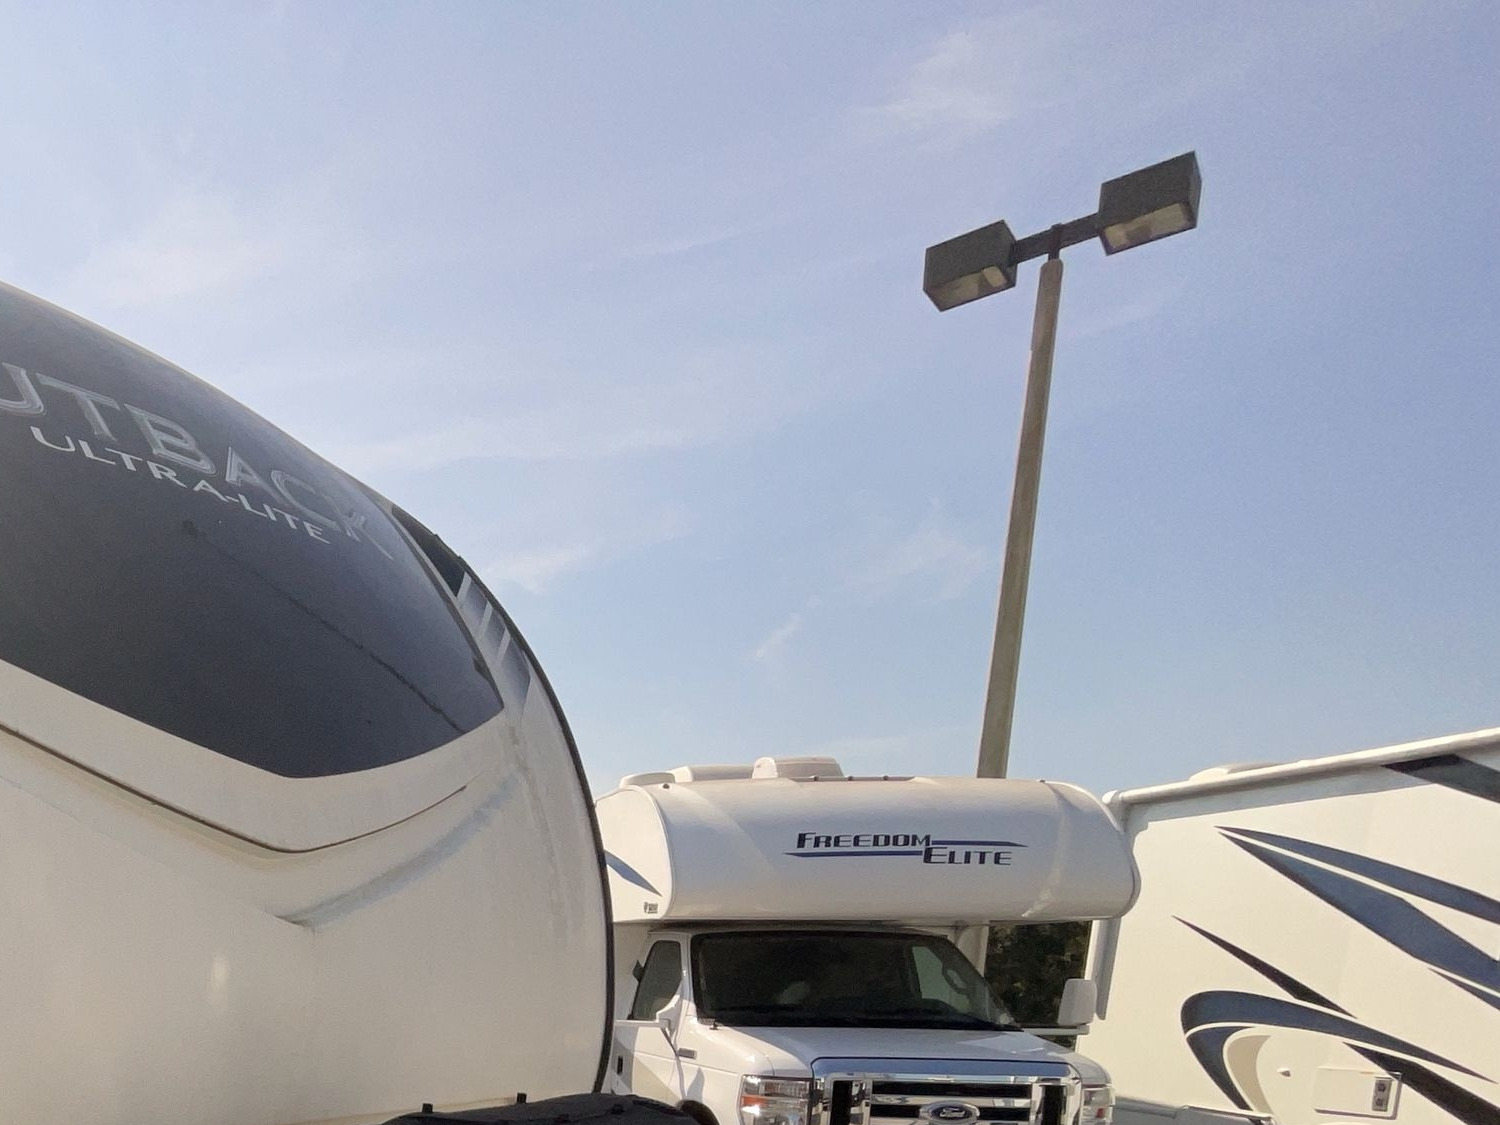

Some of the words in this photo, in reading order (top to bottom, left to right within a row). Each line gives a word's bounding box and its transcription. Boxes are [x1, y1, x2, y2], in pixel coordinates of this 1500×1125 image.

[29, 425, 331, 545] ULTRA-LITE
[796, 832, 932, 849] FREEDOM
[922, 846, 1013, 866] ELITE
